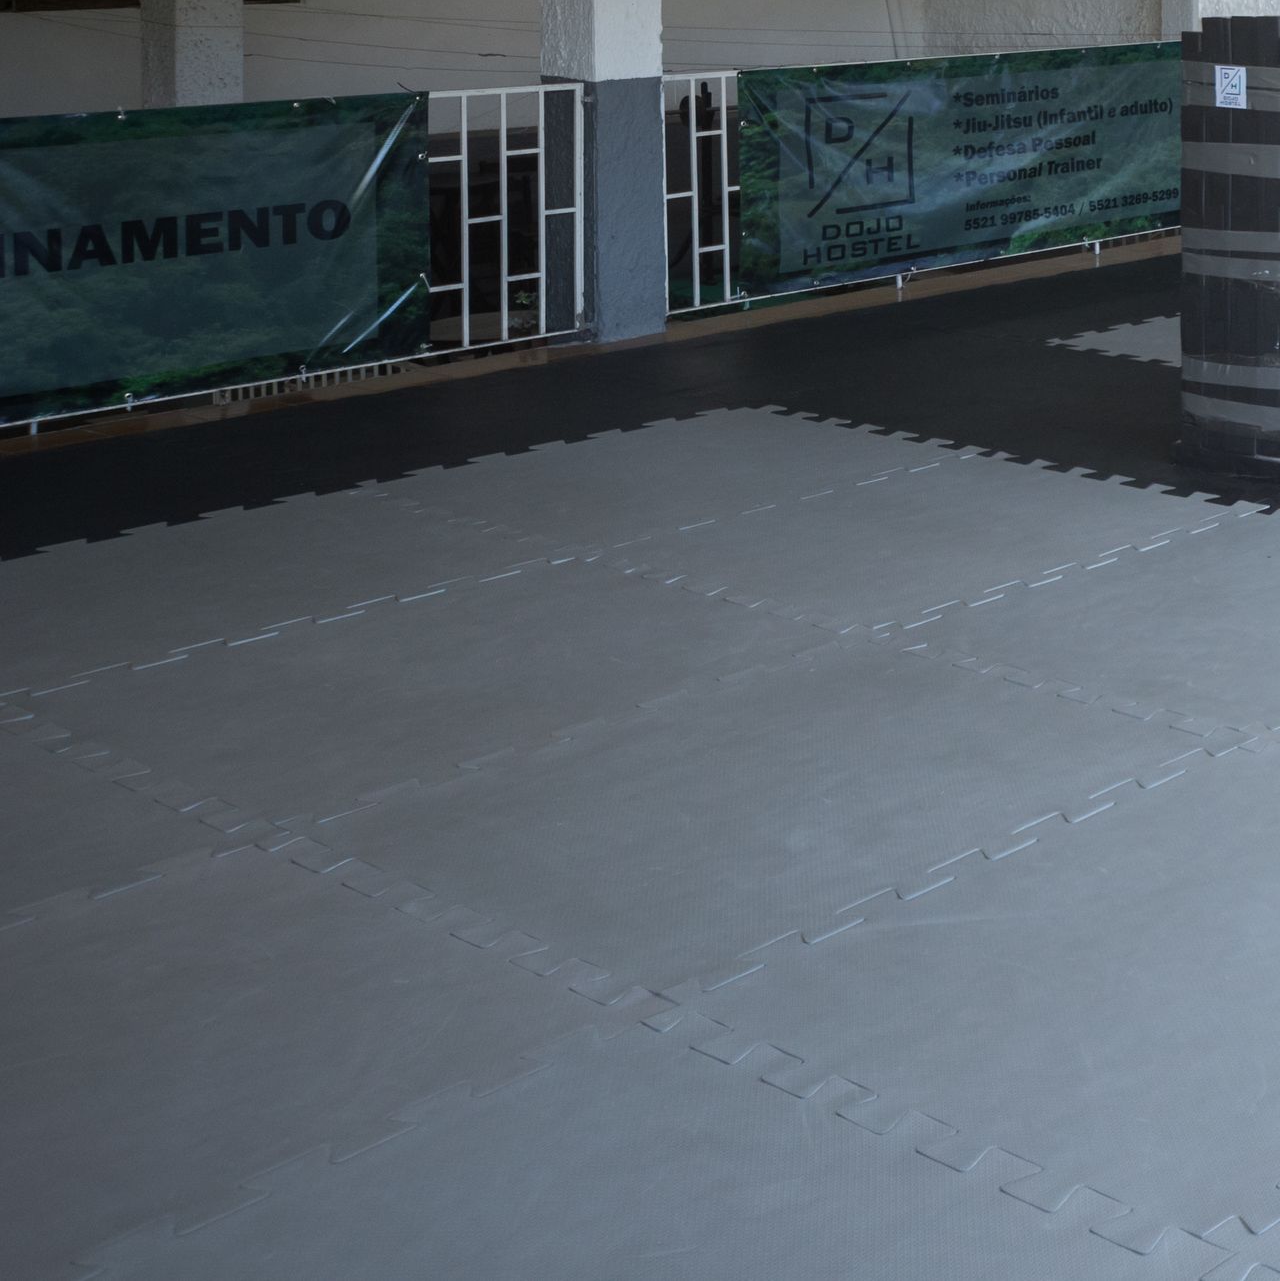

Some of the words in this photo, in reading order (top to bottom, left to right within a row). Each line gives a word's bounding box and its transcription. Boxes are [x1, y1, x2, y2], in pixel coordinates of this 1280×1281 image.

[1037, 105, 1104, 129] (Infantil
[1108, 107, 1117, 118] e
[1120, 97, 1174, 118] adulto)
[825, 116, 855, 144] D
[1032, 130, 1097, 153] Pessoal
[866, 156, 894, 184] H
[1047, 156, 1103, 175] Trainer
[822, 215, 903, 241] DOJO
[964, 215, 997, 231] 5521
[1089, 197, 1119, 212] 5521
[803, 234, 921, 265] HOSTEL
